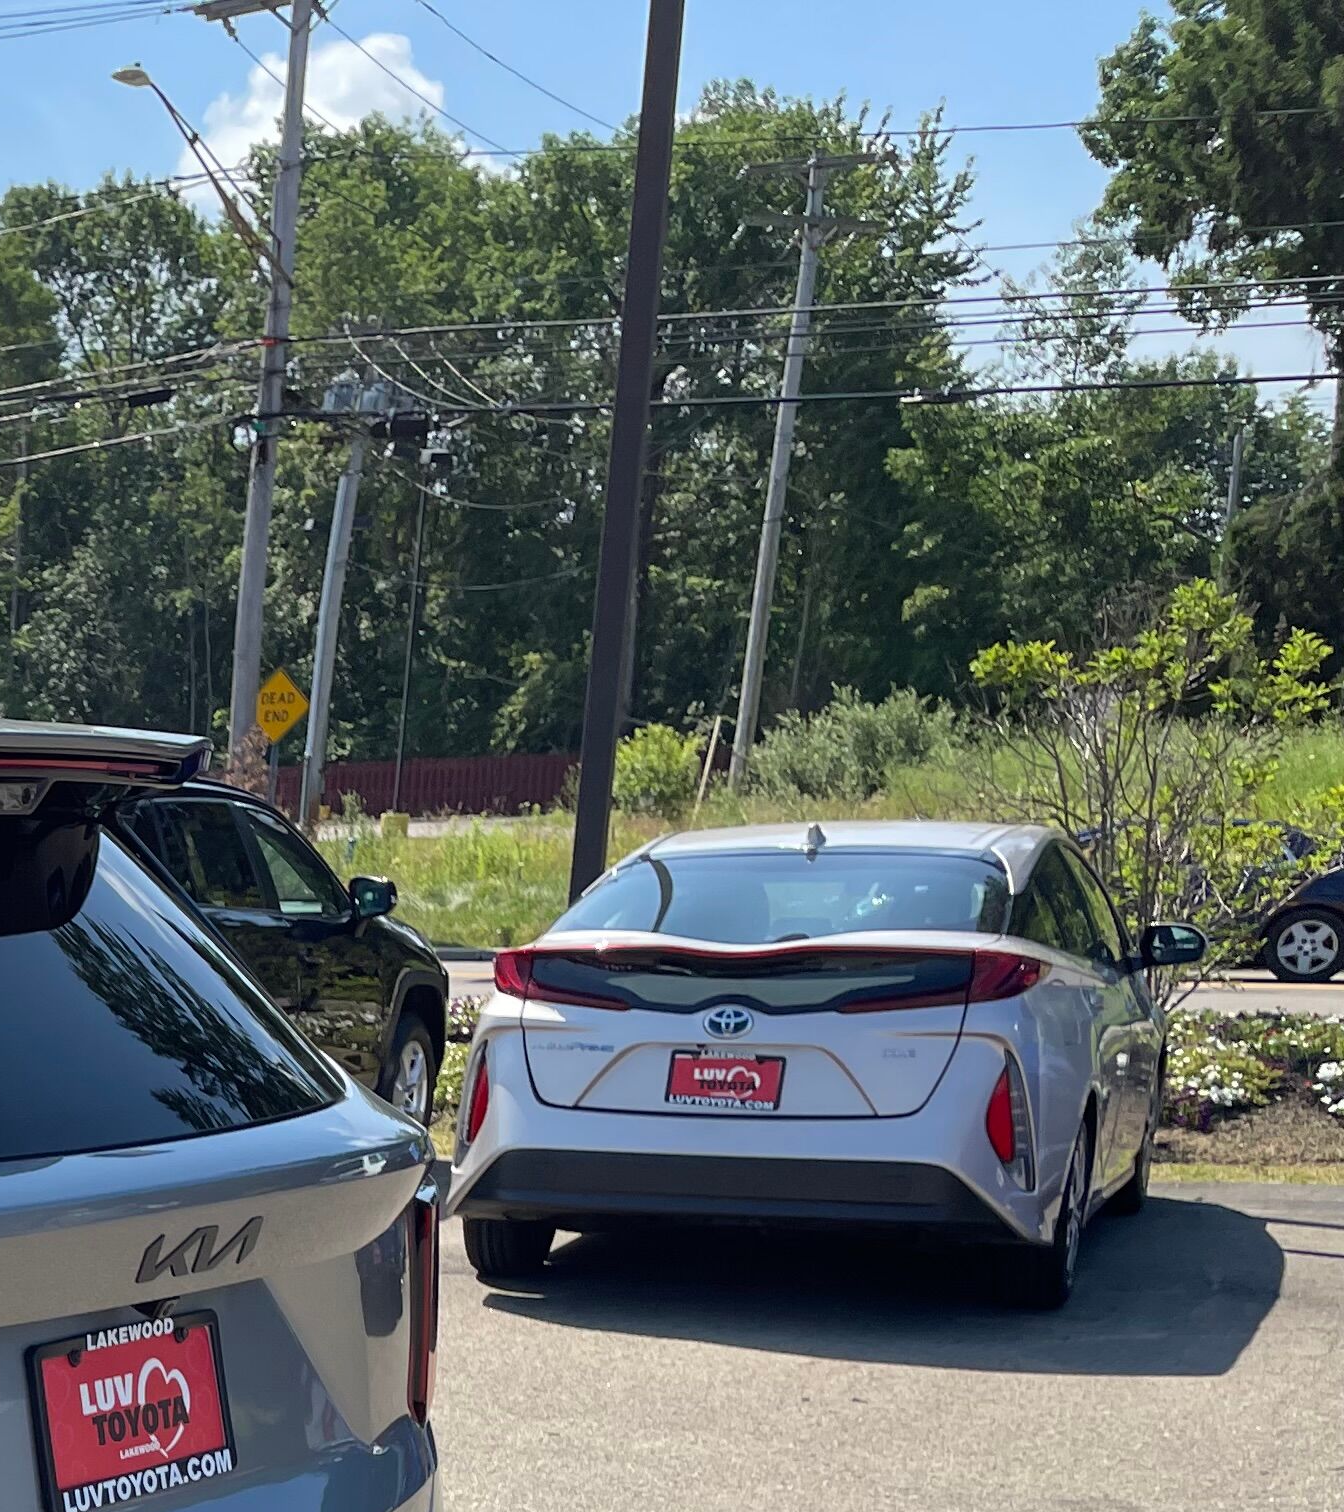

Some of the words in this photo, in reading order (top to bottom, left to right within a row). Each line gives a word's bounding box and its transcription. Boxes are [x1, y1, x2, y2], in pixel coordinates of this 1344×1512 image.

[260, 692, 296, 705] DEAD
[263, 710, 289, 723] END
[693, 1067, 727, 1080] LUV
[699, 1080, 757, 1091] TOYOTA
[669, 1094, 774, 1111] LUVTOYOTA.COM
[85, 1316, 175, 1352] LAKEWOOD
[78, 1372, 133, 1417] LUV
[92, 1396, 190, 1446] TOYOTA
